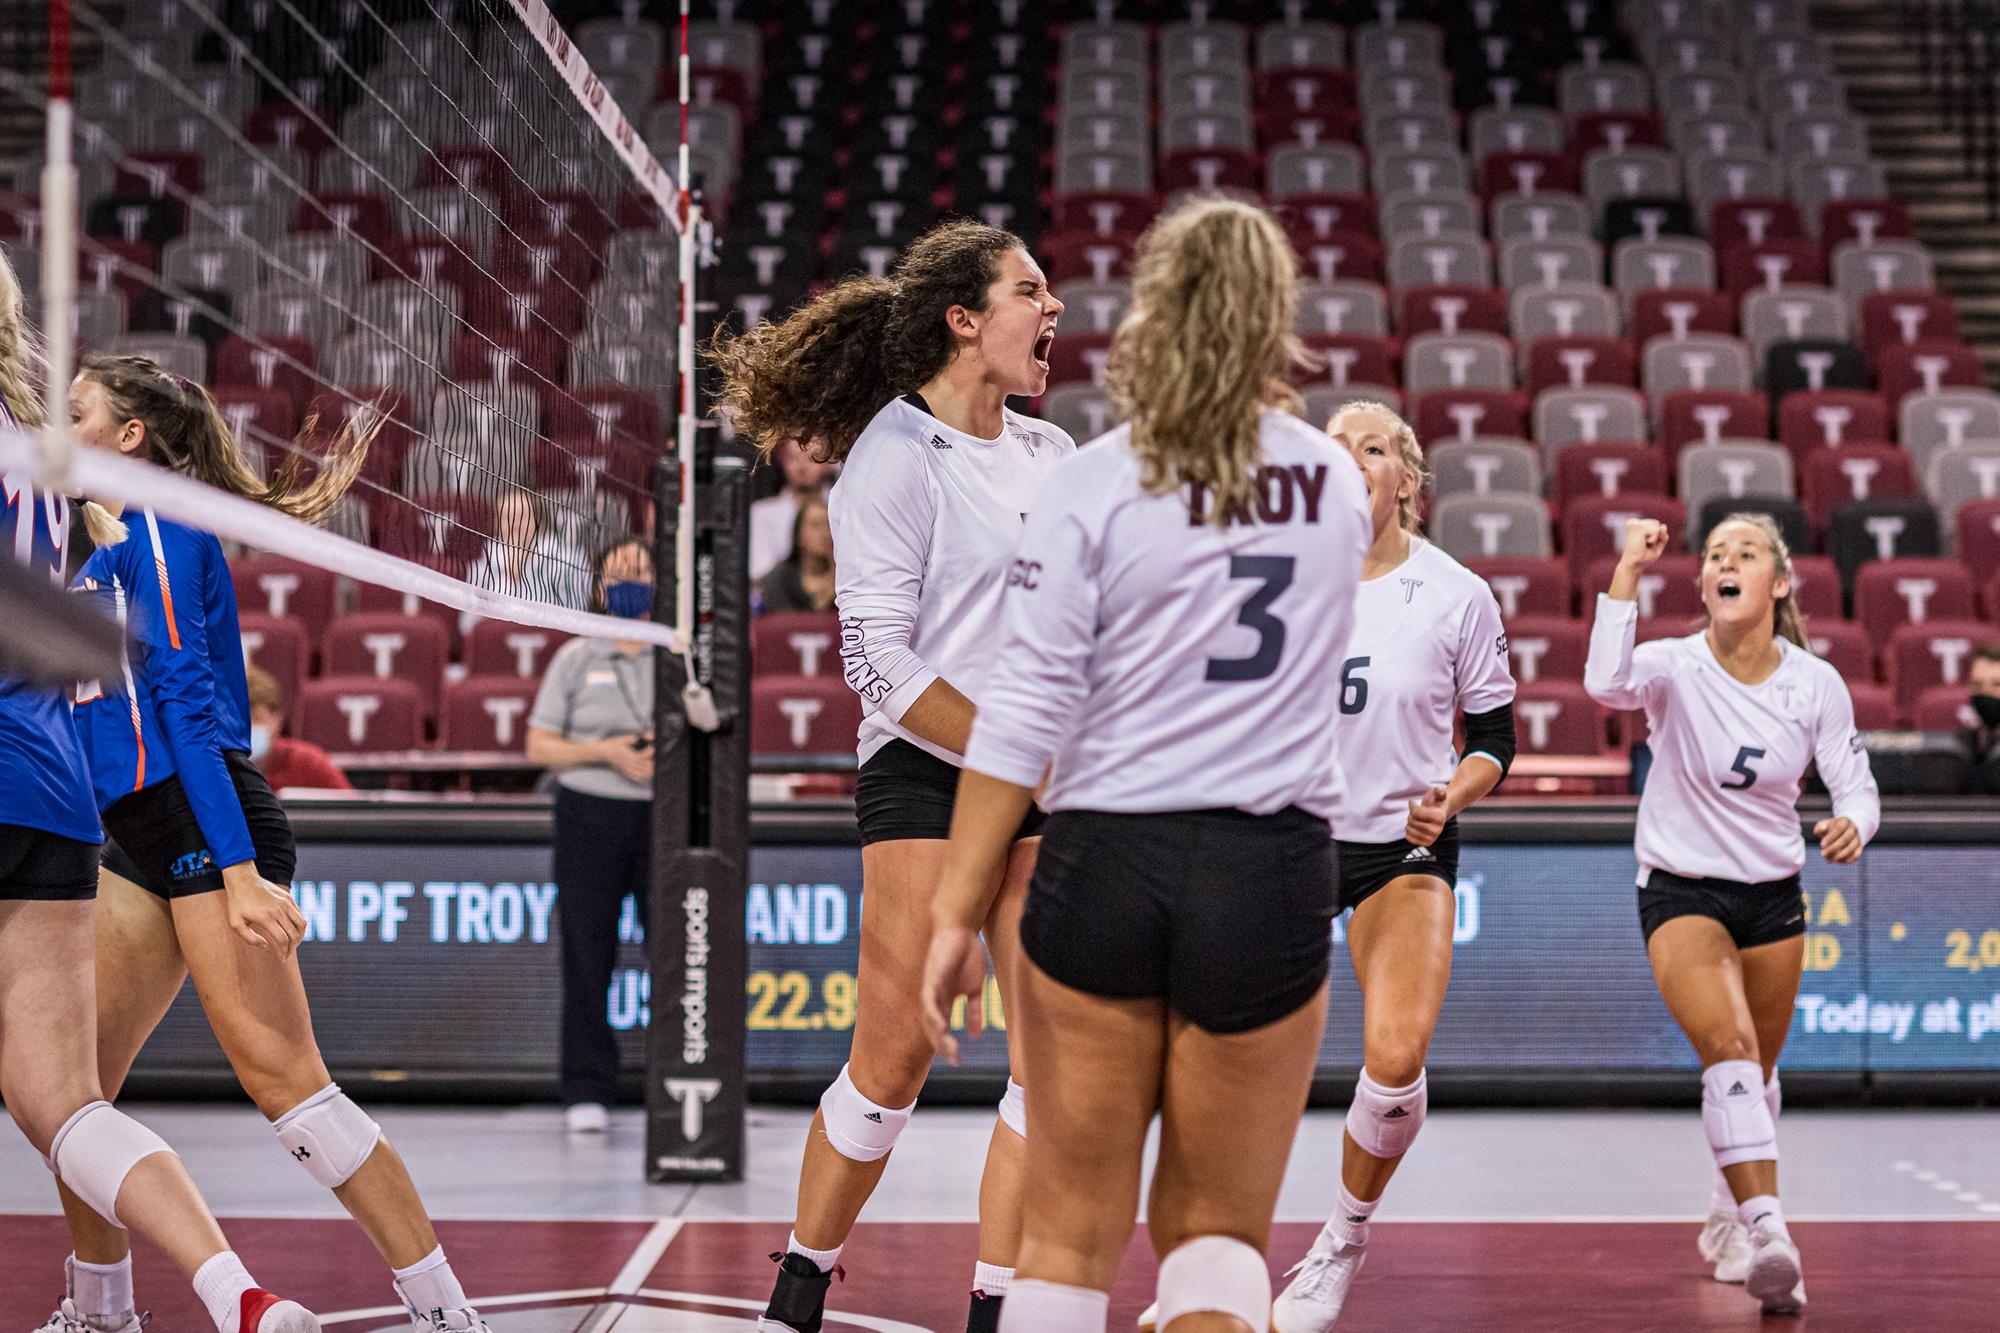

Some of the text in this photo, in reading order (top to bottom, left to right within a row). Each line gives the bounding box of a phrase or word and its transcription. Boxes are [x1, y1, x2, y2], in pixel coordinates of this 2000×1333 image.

[1083, 298, 1119, 333] T
[1316, 299, 1352, 334] T
[1431, 299, 1467, 334] T
[1547, 301, 1583, 336] T
[1662, 304, 1698, 339] T
[1777, 303, 1813, 338] T
[1892, 306, 1928, 341] T
[1322, 347, 1358, 385] T
[1440, 350, 1476, 387] T
[1559, 351, 1595, 388] T
[1679, 353, 1715, 390] T
[1798, 354, 1834, 391] T
[1913, 354, 1949, 392] T
[1078, 401, 1114, 439] T
[1447, 406, 1485, 445] T
[1570, 405, 1608, 444] T
[1693, 404, 1731, 444] T
[1814, 408, 1852, 448] T
[1936, 409, 1974, 449] T
[1463, 456, 1501, 497] T
[1590, 459, 1628, 500] T
[1717, 460, 1755, 501] T
[1841, 459, 1879, 500] T
[1967, 460, 2000, 500] T
[1470, 514, 1510, 556] T
[1865, 517, 1907, 559] T
[258, 575, 298, 618] T
[1401, 578, 1423, 604] T
[1492, 576, 1529, 617] T
[1897, 579, 1937, 623] T
[1205, 556, 1297, 681] 3
[363, 634, 403, 678] T
[505, 634, 545, 678] T
[788, 633, 832, 677] T
[1511, 640, 1549, 682] T
[1930, 639, 1969, 684] T
[1340, 656, 1371, 715] 6
[1776, 684, 1797, 709] T
[337, 696, 377, 744] T
[483, 698, 523, 744] T
[778, 699, 824, 748] T
[1519, 702, 1562, 749] T
[1720, 745, 1767, 790] 5
[291, 880, 337, 942] N
[347, 881, 416, 942] PF
[423, 881, 558, 943] TROY
[745, 884, 848, 944] AND
[745, 971, 859, 1031] 22.9
[1795, 993, 1915, 1043] Today
[1921, 997, 1963, 1034] at
[664, 1076, 722, 1141] T
